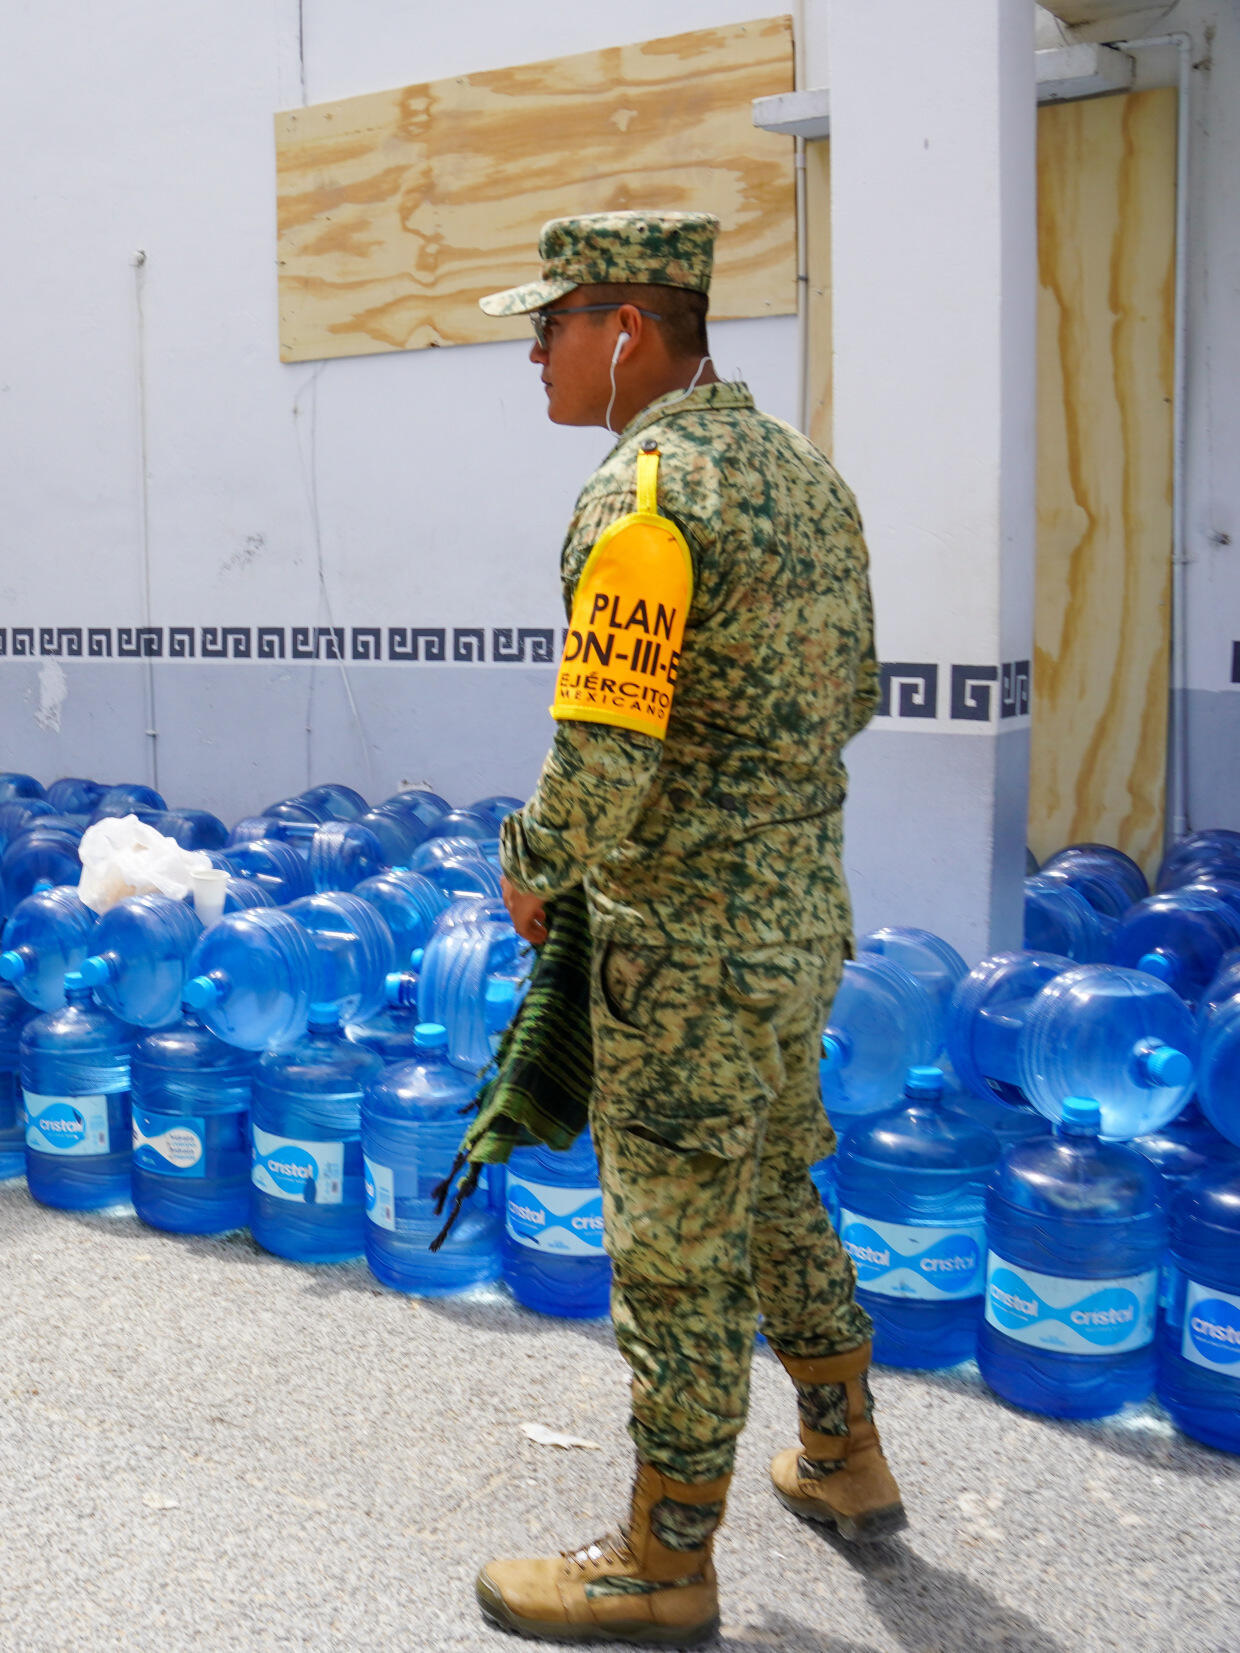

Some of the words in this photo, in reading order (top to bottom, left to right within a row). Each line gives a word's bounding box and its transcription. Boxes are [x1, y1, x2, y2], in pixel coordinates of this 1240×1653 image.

[589, 593, 677, 641] PLAN
[560, 671, 671, 709] EJÉRCITO
[560, 689, 666, 720] MEXICANO
[266, 1158, 314, 1182] cristal
[571, 1212, 605, 1230] cris
[919, 1250, 976, 1273] cristal
[990, 1284, 1040, 1318] cristal
[1069, 1304, 1135, 1327] cristal
